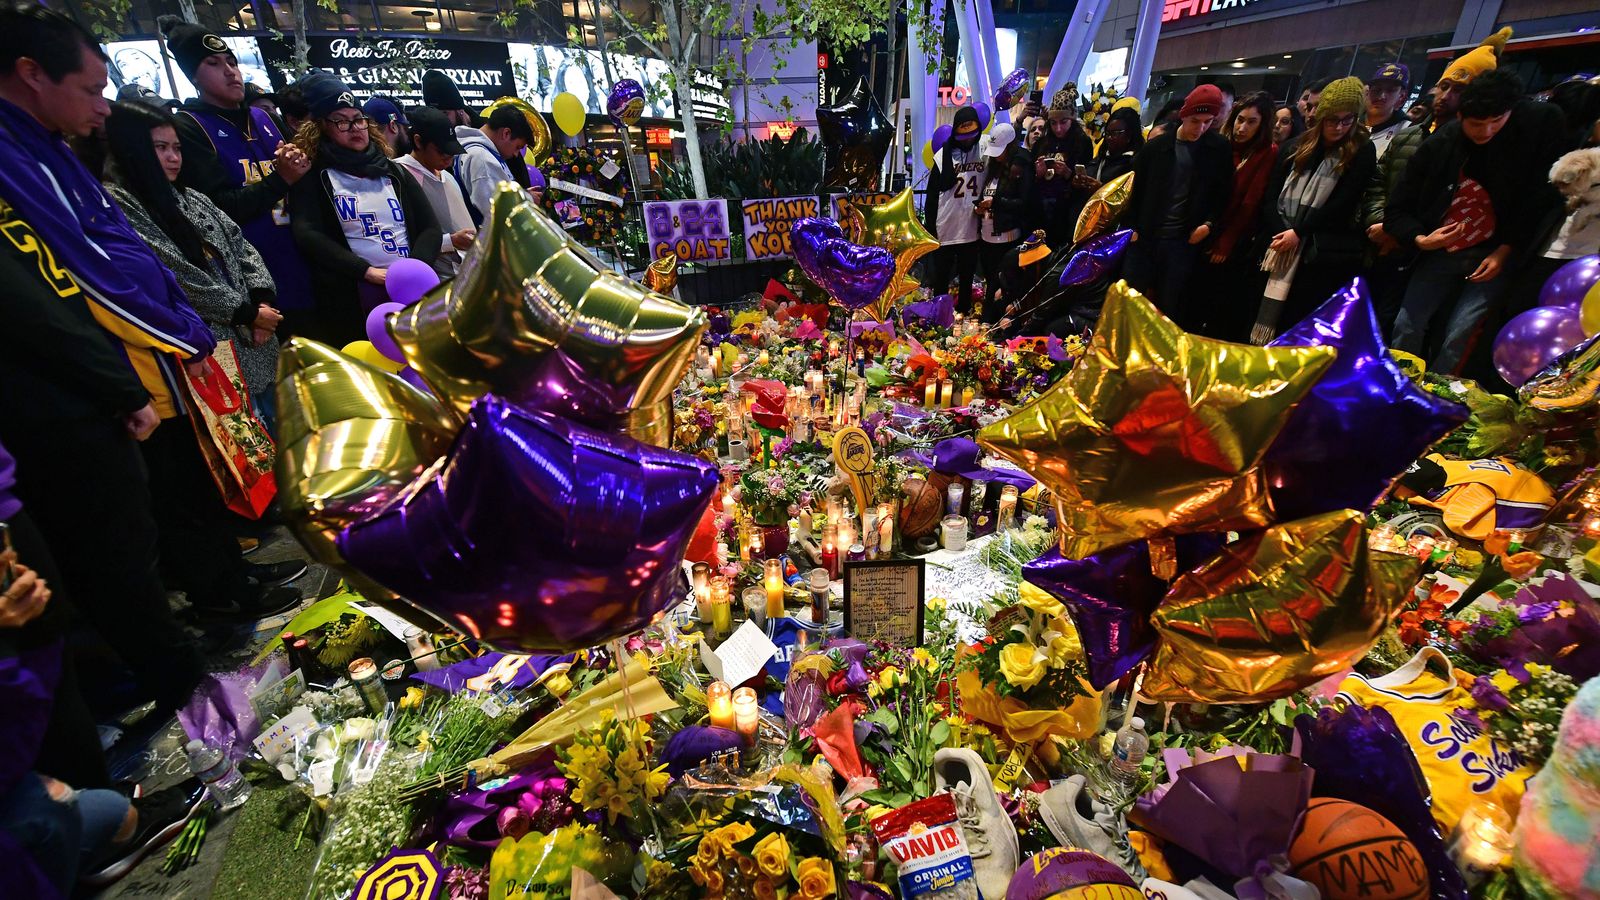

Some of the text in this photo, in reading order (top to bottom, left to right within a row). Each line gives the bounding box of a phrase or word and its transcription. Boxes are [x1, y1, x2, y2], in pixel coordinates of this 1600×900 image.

[1161, 0, 1212, 22] SPN
[330, 38, 451, 60] Rest In Peace
[340, 67, 356, 85] &
[358, 67, 424, 85] GIANN
[441, 68, 502, 86] RYANT
[239, 158, 277, 187] LAK
[953, 175, 979, 199] 24
[387, 198, 404, 222] 8
[648, 202, 725, 239] 8 & 24
[743, 198, 818, 226] THANK
[334, 195, 410, 258] WEST
[748, 231, 793, 258] KOB
[258, 725, 290, 750] MAMBA
[997, 756, 1023, 786] KOBE
[891, 826, 960, 864] DAVID
[914, 862, 965, 884] ORIGINAL
[930, 874, 955, 891] Jumbo
